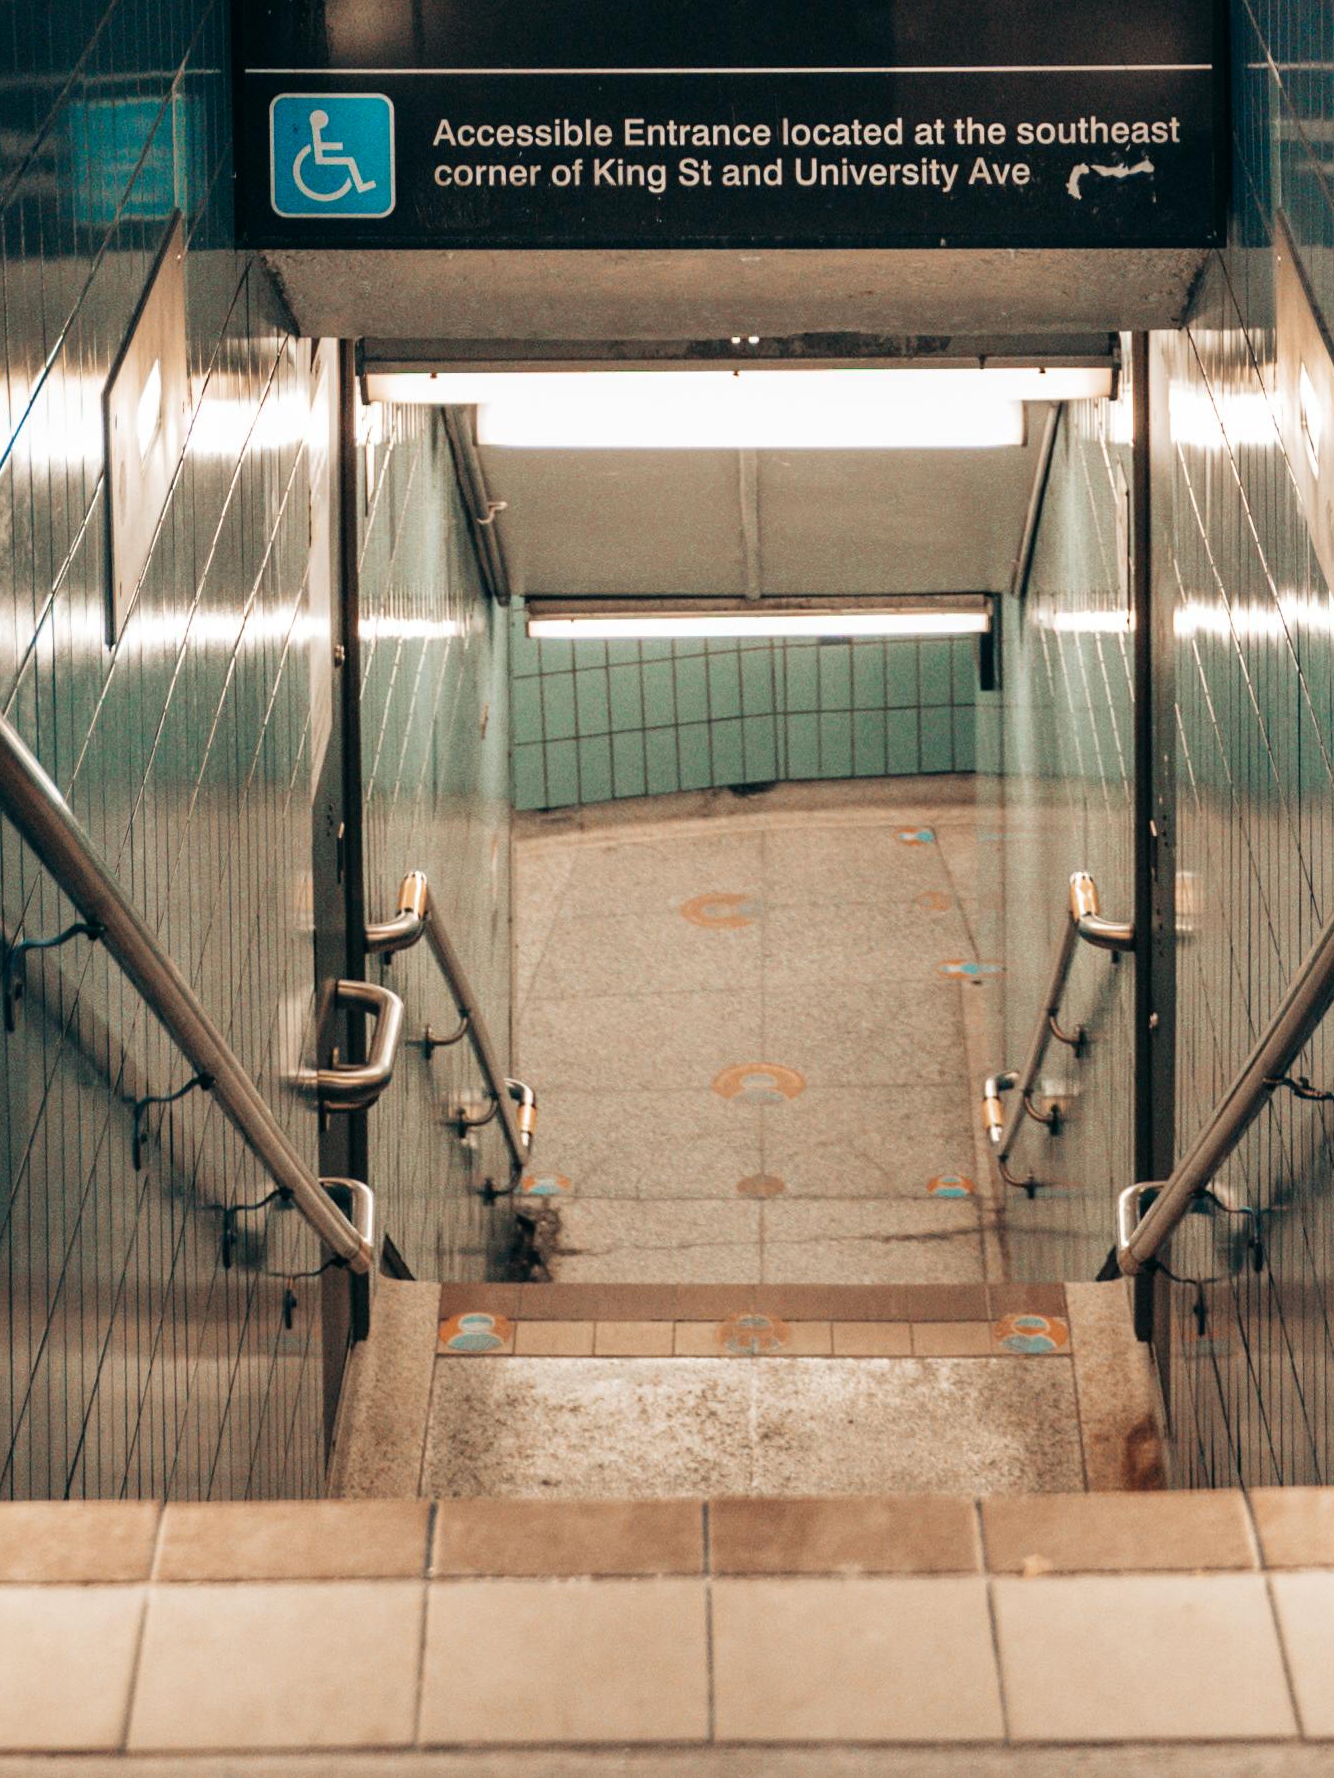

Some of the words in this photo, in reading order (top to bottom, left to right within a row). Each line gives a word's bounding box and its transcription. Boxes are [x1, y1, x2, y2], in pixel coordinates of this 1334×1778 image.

[432, 118, 613, 147] Accessible
[624, 118, 772, 146] Entrance
[782, 117, 903, 146] located
[914, 118, 945, 146] at
[953, 116, 1007, 145] the
[1016, 115, 1180, 145] southeast
[434, 163, 542, 186] corner
[551, 158, 583, 187] of
[594, 158, 667, 194] King
[678, 157, 712, 187] St
[722, 157, 783, 186] and
[795, 157, 959, 193] University
[968, 157, 1031, 185] Ave
